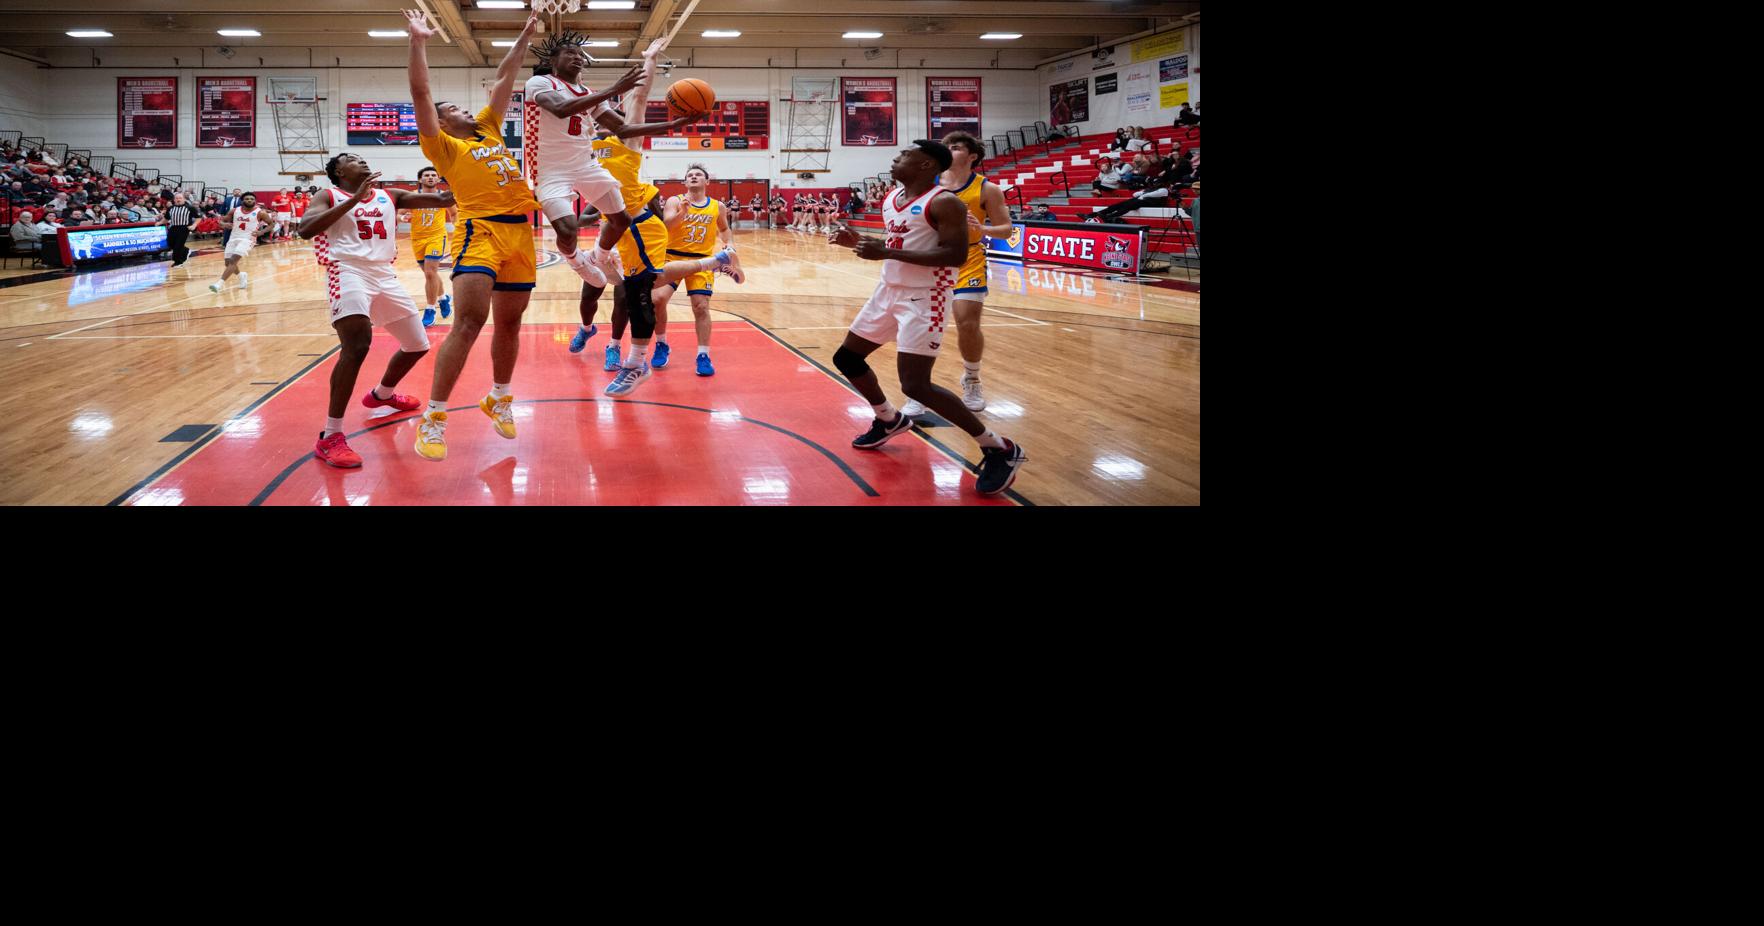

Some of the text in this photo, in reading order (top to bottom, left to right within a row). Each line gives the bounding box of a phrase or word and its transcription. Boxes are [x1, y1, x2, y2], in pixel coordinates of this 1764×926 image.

[568, 116, 582, 136] 0
[701, 138, 711, 148] G
[238, 222, 246, 231] 4
[356, 220, 387, 240] 54
[684, 224, 707, 243] 33
[1028, 234, 1095, 260] STATE
